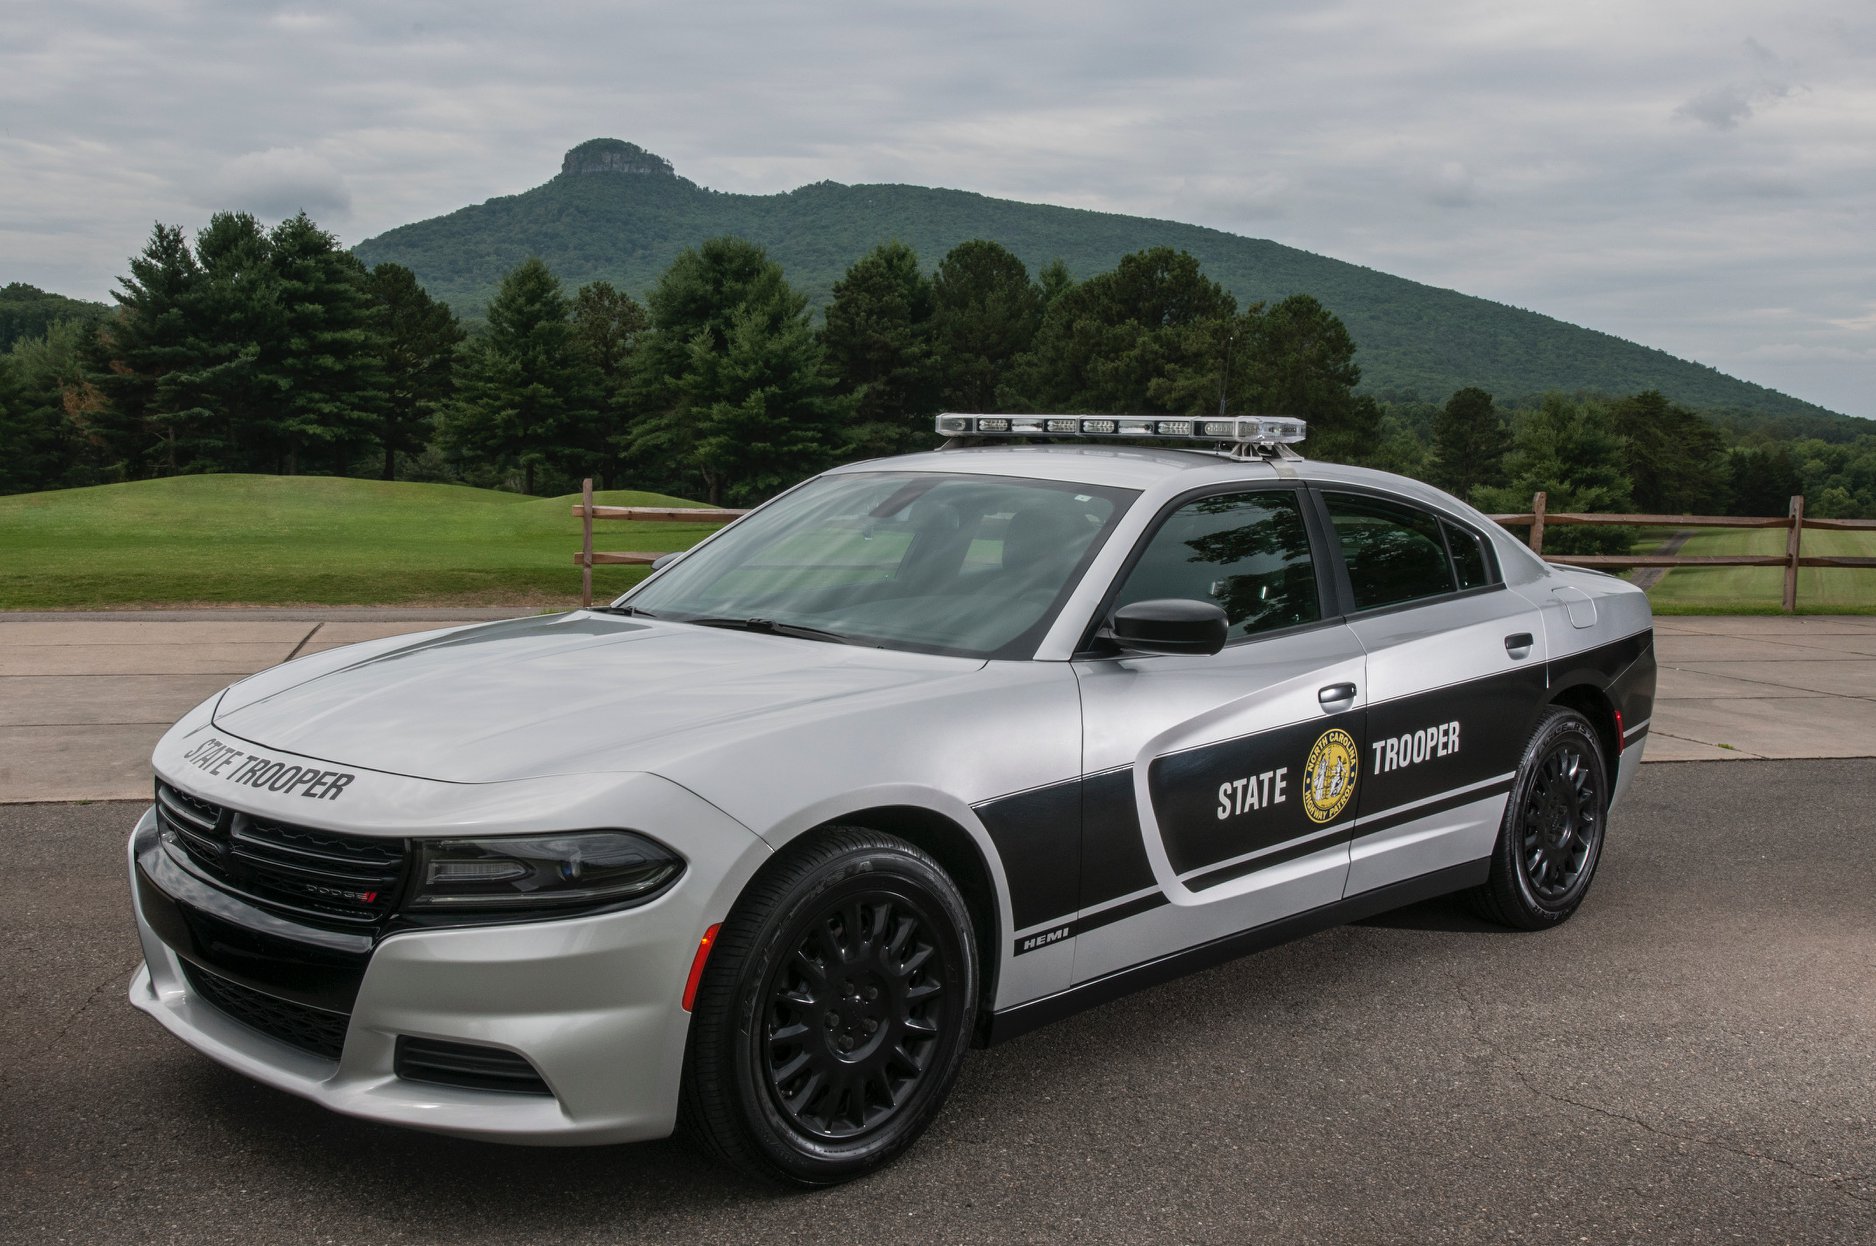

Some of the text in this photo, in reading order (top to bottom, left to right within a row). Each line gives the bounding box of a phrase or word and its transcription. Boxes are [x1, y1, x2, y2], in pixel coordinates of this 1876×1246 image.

[183, 738, 356, 800] STATE TROOPER
[1217, 721, 1460, 820] STATE TROOPER
[1307, 732, 1356, 772] NORTH CAROLINA
[1304, 783, 1354, 820] HIGHWAY PATROL
[1023, 927, 1069, 950] HEMI
